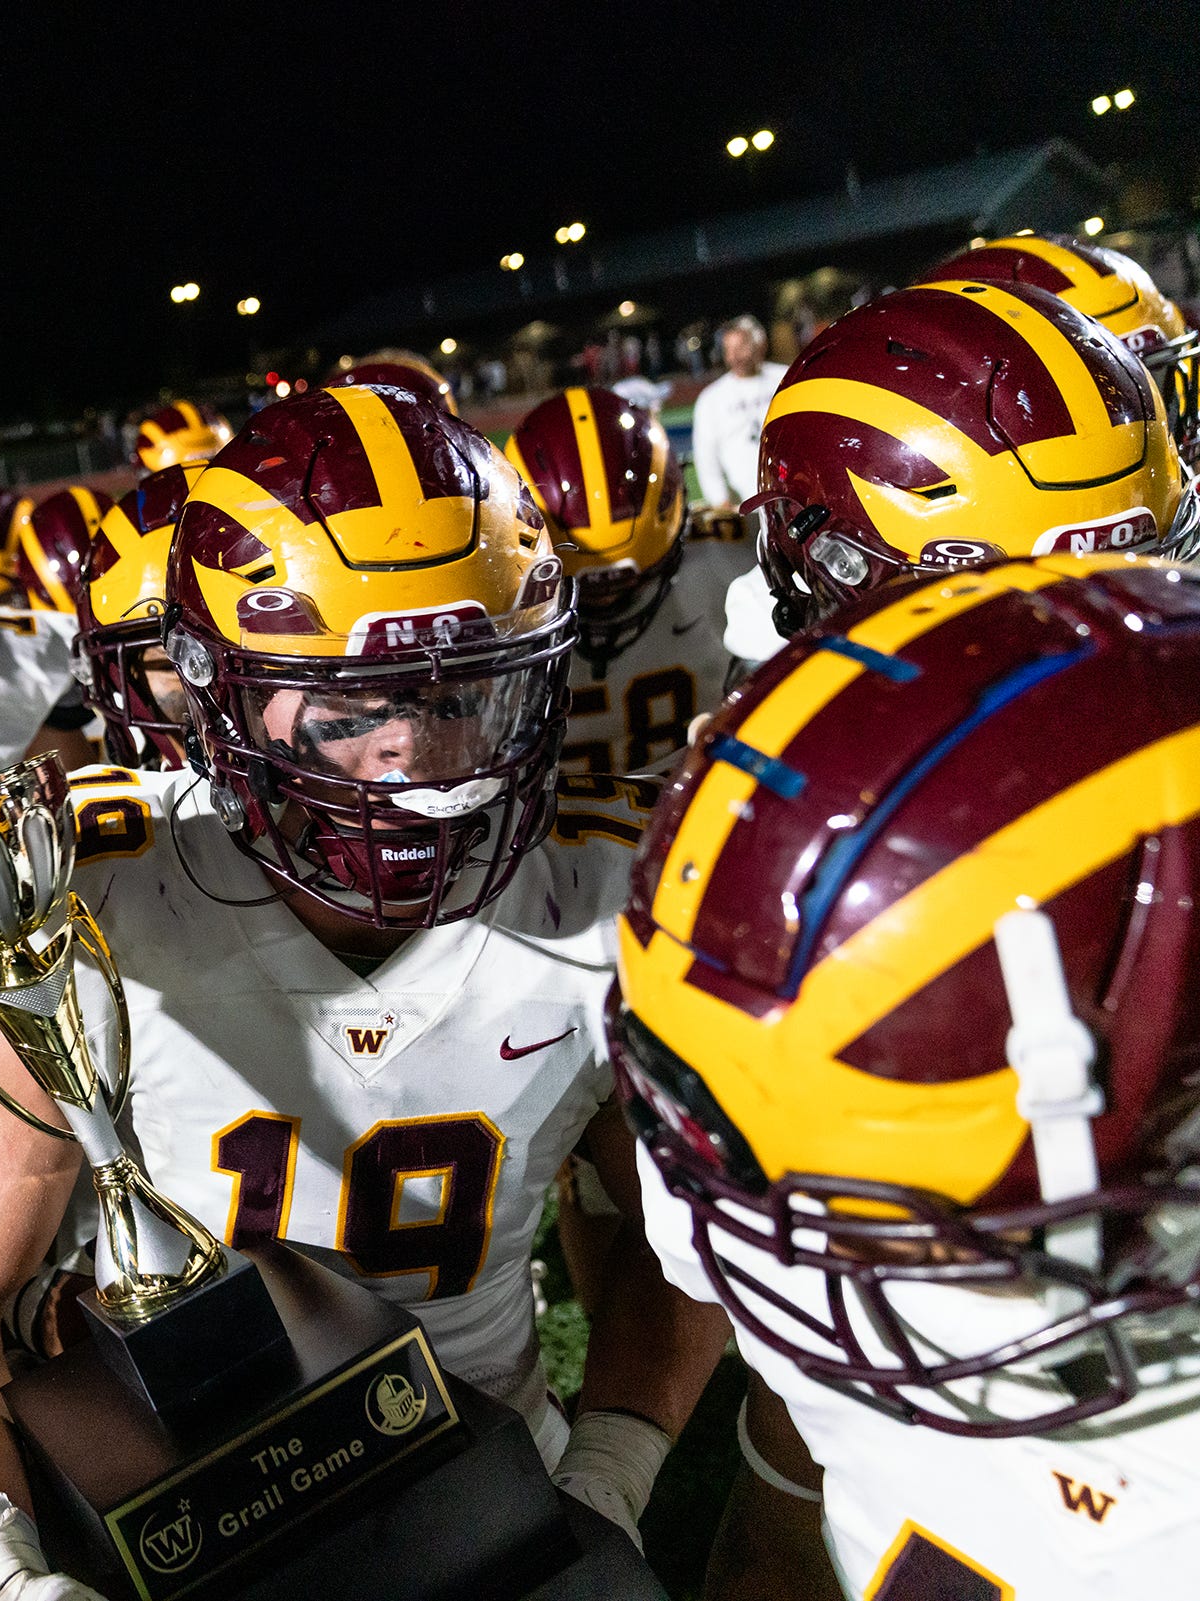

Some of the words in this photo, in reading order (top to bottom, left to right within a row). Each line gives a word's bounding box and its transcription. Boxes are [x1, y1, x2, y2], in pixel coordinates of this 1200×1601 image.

[381, 846, 436, 861] Riddell
[346, 1027, 388, 1055] W
[211, 1109, 506, 1300] 19
[251, 1438, 303, 1475] The
[218, 1484, 284, 1537] Grail
[290, 1439, 365, 1492] Game
[1052, 1470, 1116, 1524] W
[145, 1514, 192, 1564] W
